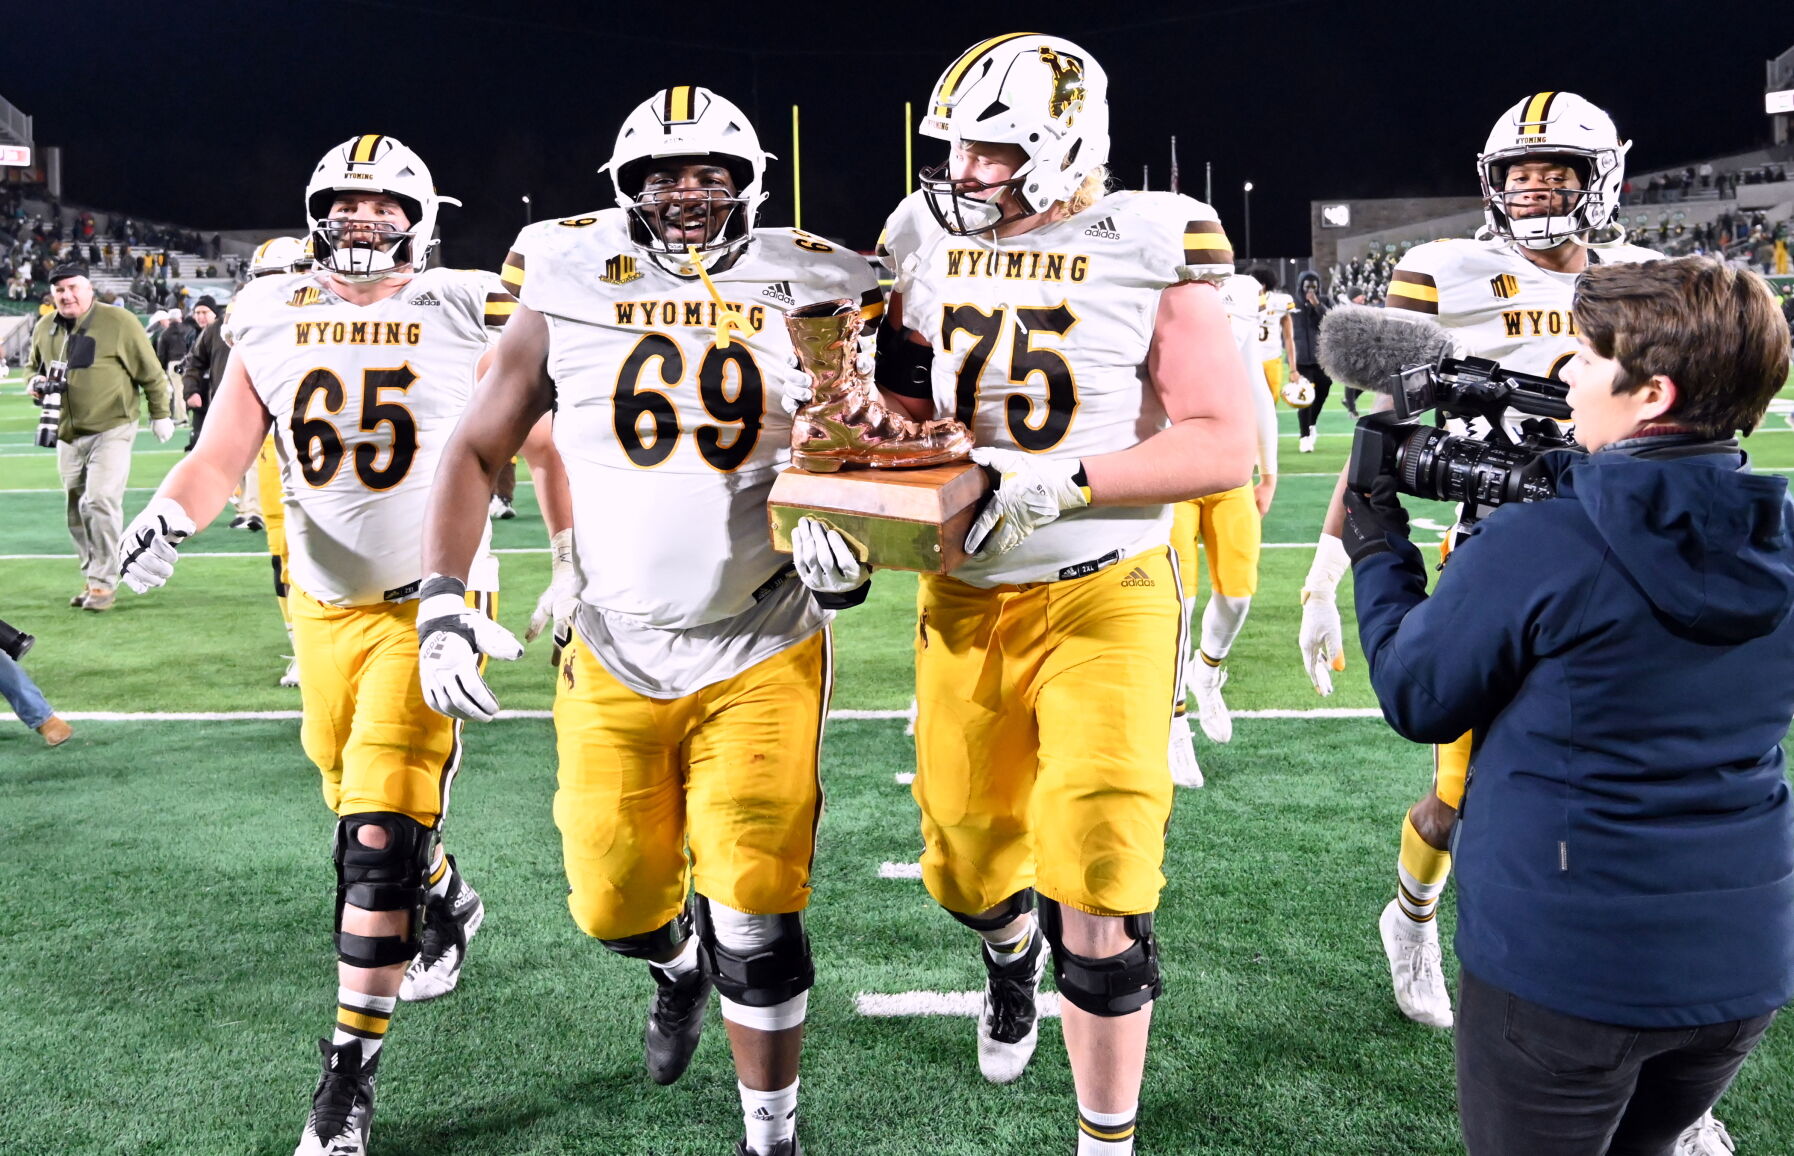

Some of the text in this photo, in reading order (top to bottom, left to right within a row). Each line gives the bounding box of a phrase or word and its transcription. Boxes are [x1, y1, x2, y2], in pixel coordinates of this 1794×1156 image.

[1515, 136, 1547, 145] WYOMING
[344, 172, 374, 180] WYOMING
[1084, 229, 1121, 240] adidas
[947, 249, 1091, 284] WYOMING
[410, 299, 441, 307] adidas
[762, 288, 796, 306] adidas
[295, 320, 422, 347] WYOMING
[940, 298, 1083, 455] 75
[609, 331, 767, 475] 69
[288, 361, 422, 493] 65
[1082, 565, 1095, 573] 2XL
[1121, 577, 1156, 588] adidas
